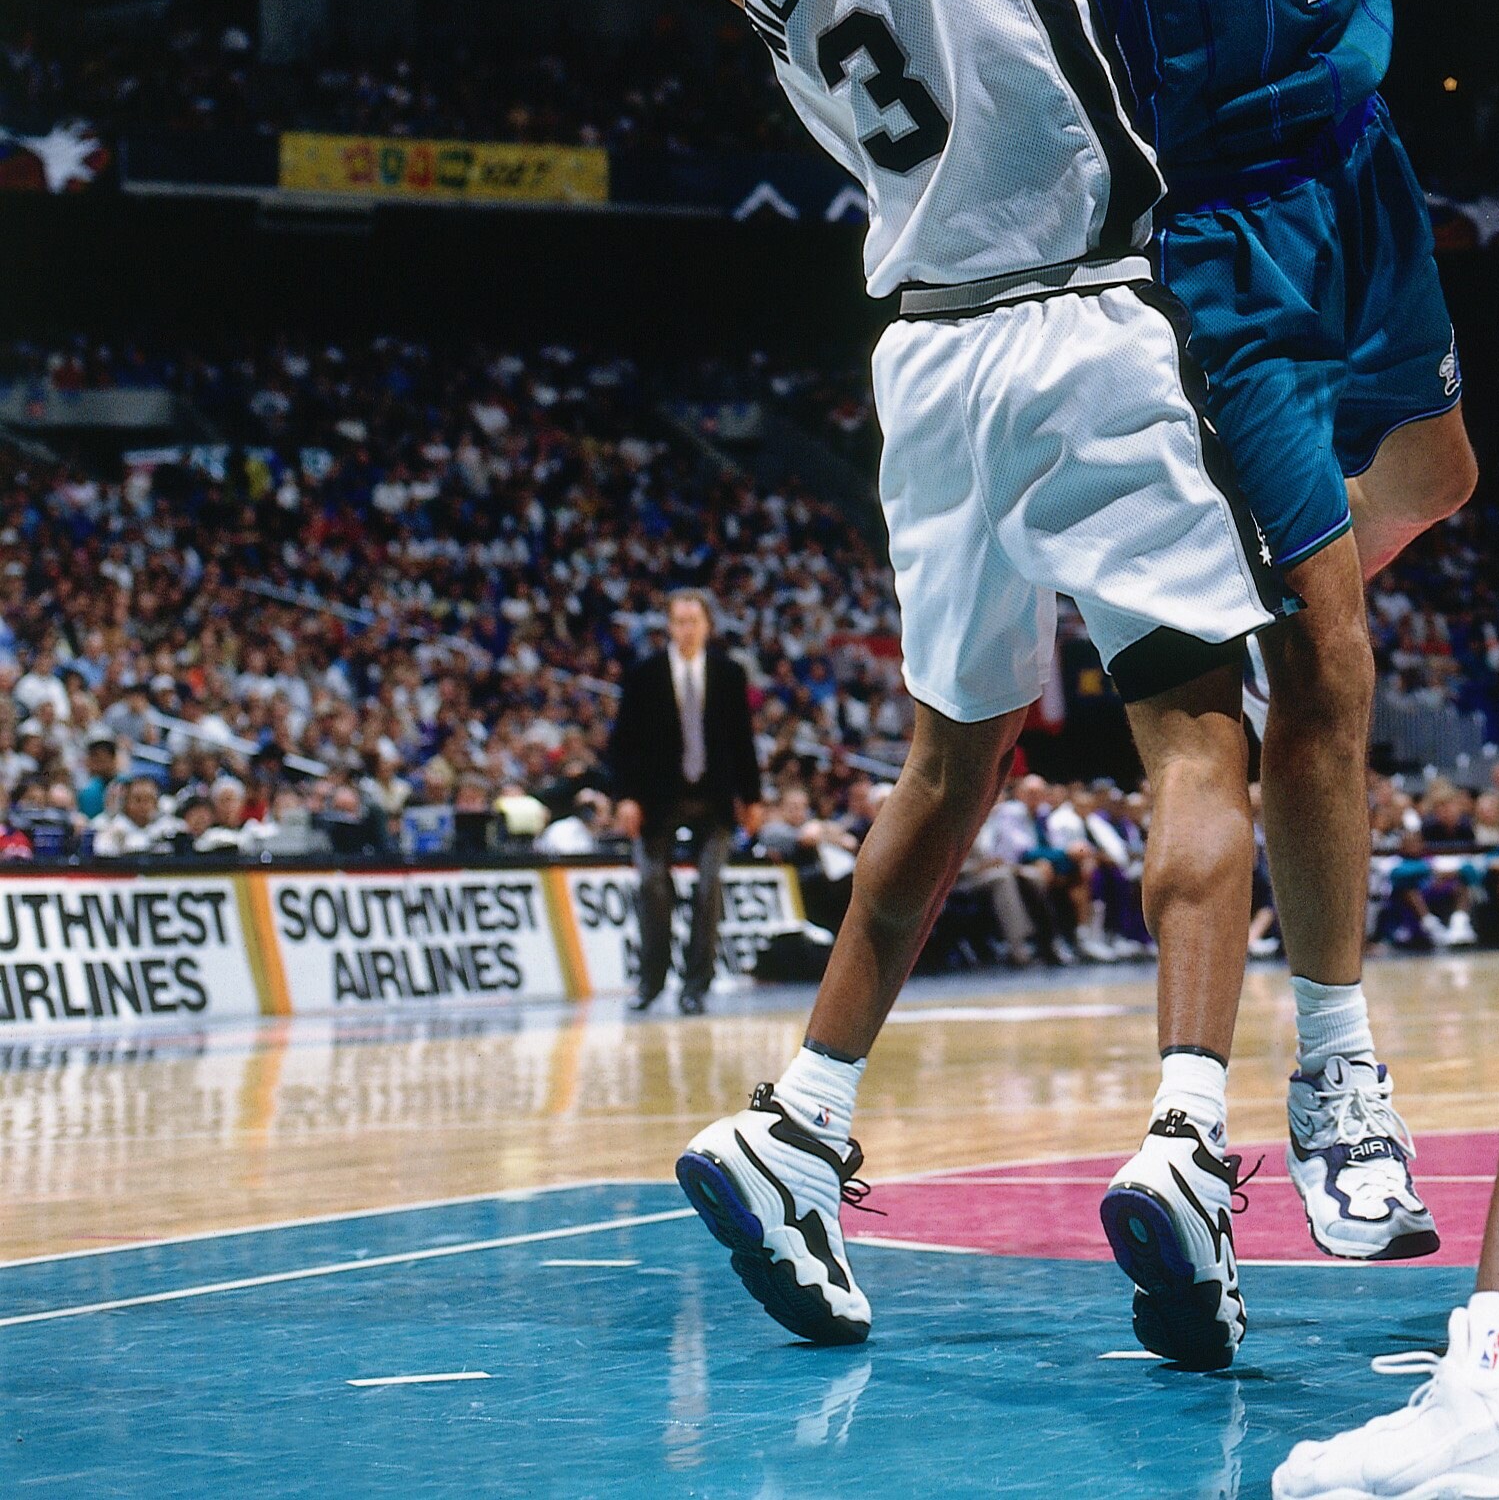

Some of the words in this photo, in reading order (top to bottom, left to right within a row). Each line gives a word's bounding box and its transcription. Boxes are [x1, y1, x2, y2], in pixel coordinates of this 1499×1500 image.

[815, 6, 954, 177] 3
[278, 884, 537, 941] SOUTHWEST
[0, 956, 208, 1020] IRLINES
[334, 942, 522, 1001] AIRLINES
[1349, 1140, 1386, 1160] AIR
